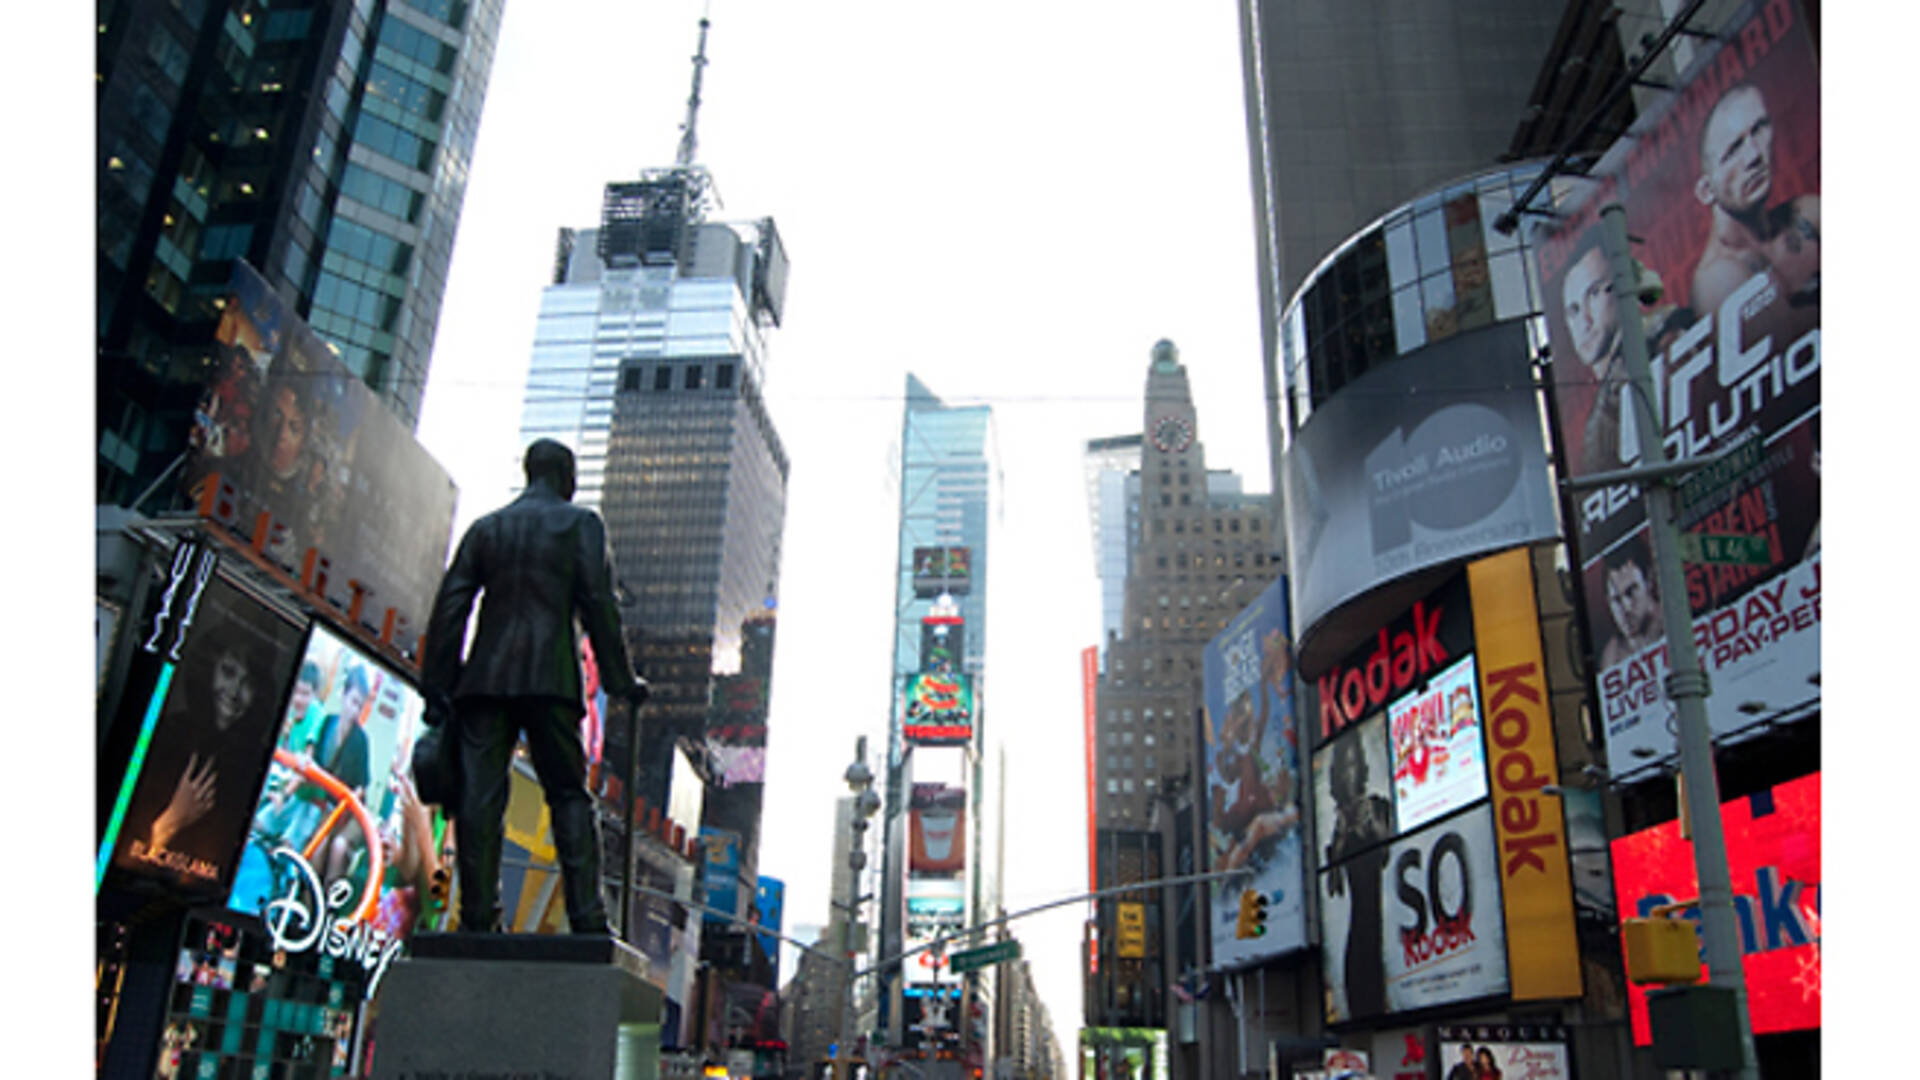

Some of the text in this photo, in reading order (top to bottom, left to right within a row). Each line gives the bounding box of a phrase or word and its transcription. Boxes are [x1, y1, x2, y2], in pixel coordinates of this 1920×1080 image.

[1373, 453, 1430, 492] Tivoli
[1436, 433, 1508, 468] Audio
[1706, 539, 1721, 560] W
[1319, 600, 1450, 740] Kodak
[1602, 579, 1788, 699] SATRDAY
[1605, 679, 1659, 722] LIVE
[1484, 660, 1558, 879] Kodak
[1396, 832, 1471, 944] SO
[1402, 908, 1477, 968] Kodak
